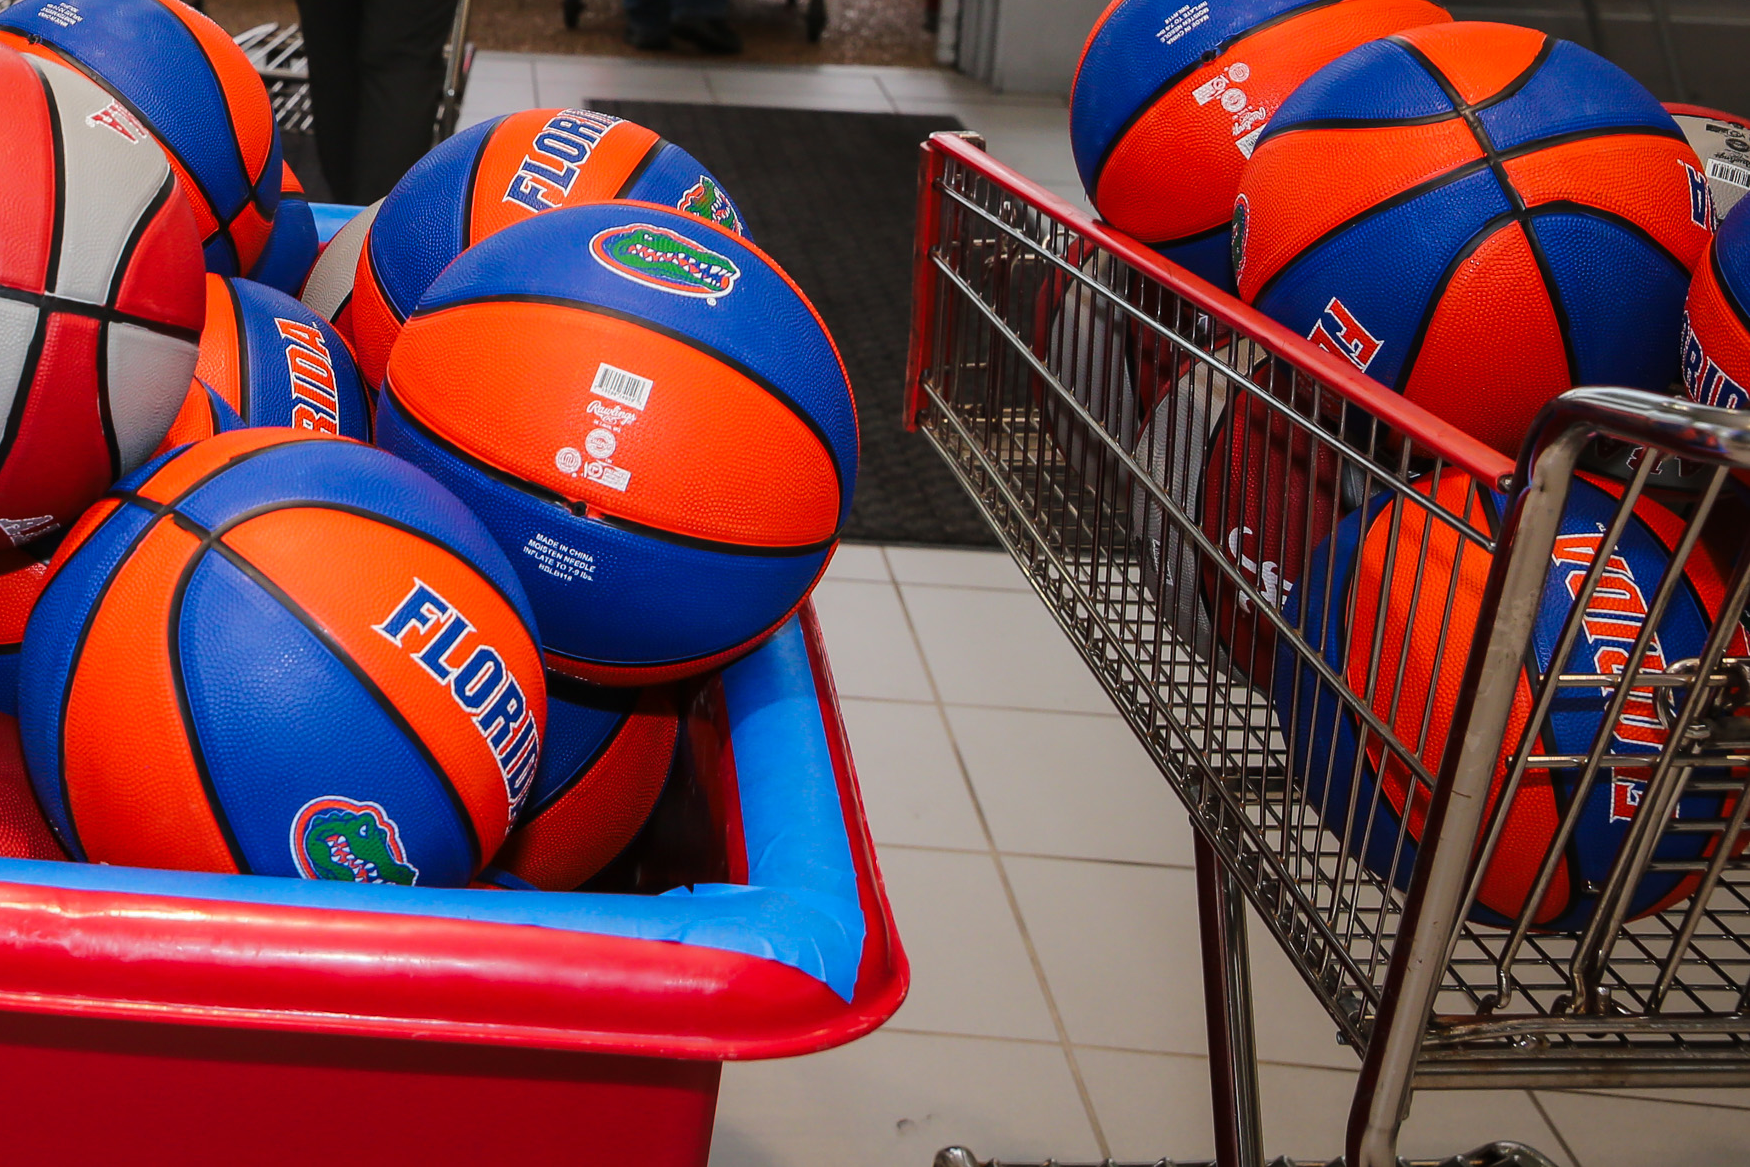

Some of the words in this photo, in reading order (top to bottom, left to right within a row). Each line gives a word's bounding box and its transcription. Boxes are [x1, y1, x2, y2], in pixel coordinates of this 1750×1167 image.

[1167, 29, 1186, 45] CHINA
[586, 400, 637, 425] Rawlings
[523, 545, 554, 566] INFLATE
[528, 539, 563, 560] MOISTEN
[536, 533, 558, 548] MADE
[569, 548, 593, 563] CHINA
